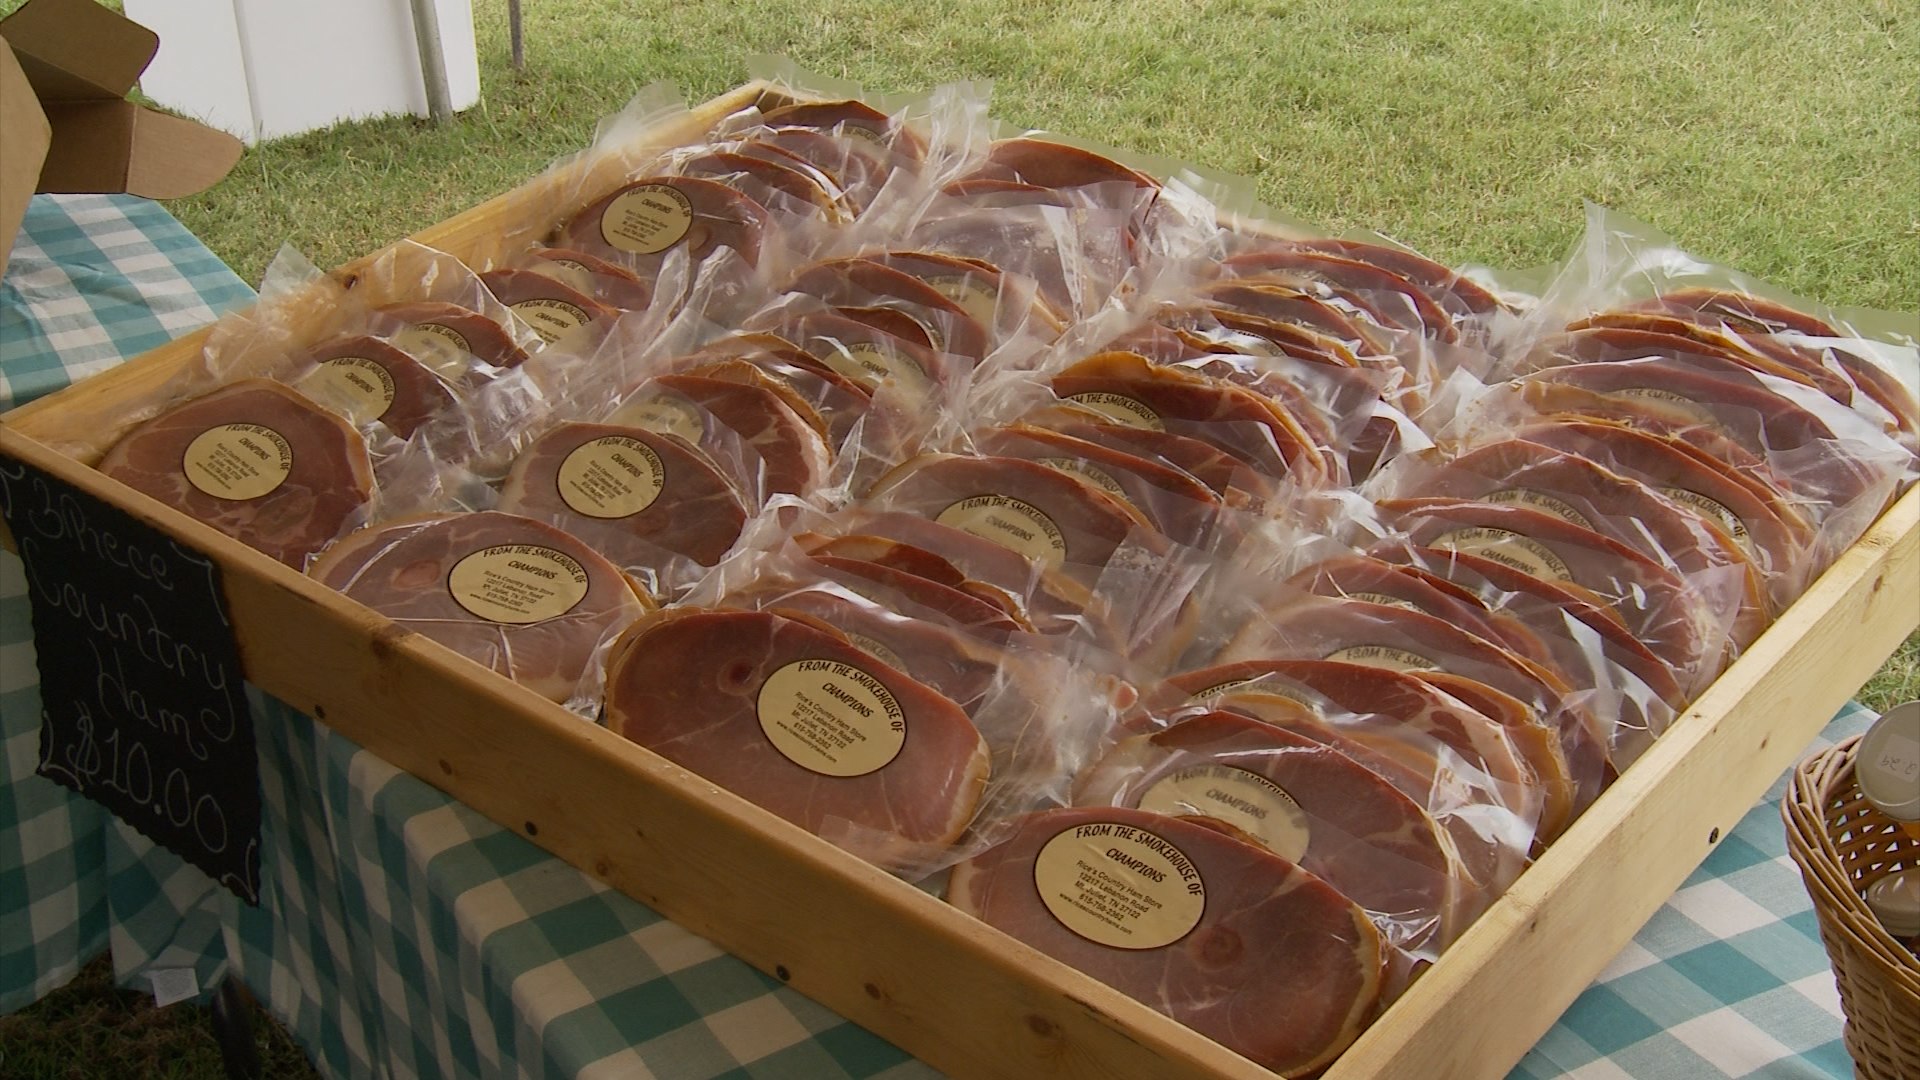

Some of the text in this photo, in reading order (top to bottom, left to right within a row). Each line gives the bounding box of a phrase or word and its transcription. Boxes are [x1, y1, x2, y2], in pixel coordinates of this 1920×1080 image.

[1086, 393, 1104, 404] THE
[238, 437, 272, 461] CHAMPIONS
[280, 462, 290, 471] OF
[611, 453, 644, 478] CHAMPIONS
[652, 479, 662, 488] OF
[1488, 491, 1518, 504] FROM
[1521, 490, 1539, 504] THE
[960, 497, 1064, 550] FROM THE SMOKEHOUSE OF
[985, 515, 1035, 541] CHAMPIONS
[1452, 528, 1482, 542] FROM
[1487, 529, 1506, 540] THE
[1733, 525, 1747, 537] OF
[483, 546, 587, 584] FROM THE SMOKEHOUSE OF
[507, 560, 558, 580] CHAMPIONS
[1480, 548, 1538, 575] CHAMPIONS
[22, 536, 236, 742] Country
[1346, 647, 1381, 660] FROM
[1383, 649, 1405, 661] THE
[87, 637, 208, 761] Ham
[798, 661, 904, 733] FROM THE SMOKEHOUSE OF
[821, 682, 875, 718] CHAMPIONS
[796, 702, 856, 744] 12217 Lebanon Road
[813, 703, 837, 722] Country
[836, 717, 851, 731] Ham
[850, 726, 867, 742] Store
[819, 727, 829, 737] TN
[828, 733, 848, 749] 37122
[66, 699, 228, 853] $10.00
[1175, 767, 1209, 783] FROM
[1205, 788, 1270, 820] CHAMPIONS
[1075, 825, 1203, 896] FROM THE SMOKEHOUSE OF
[1105, 848, 1167, 883] CHAMPIONS
[1074, 880, 1142, 920] Mt. Juliet, TN 37122
[1076, 860, 1163, 909] Rice's Country Ham Store
[1078, 871, 1149, 914] 12217 Lebanon Road
